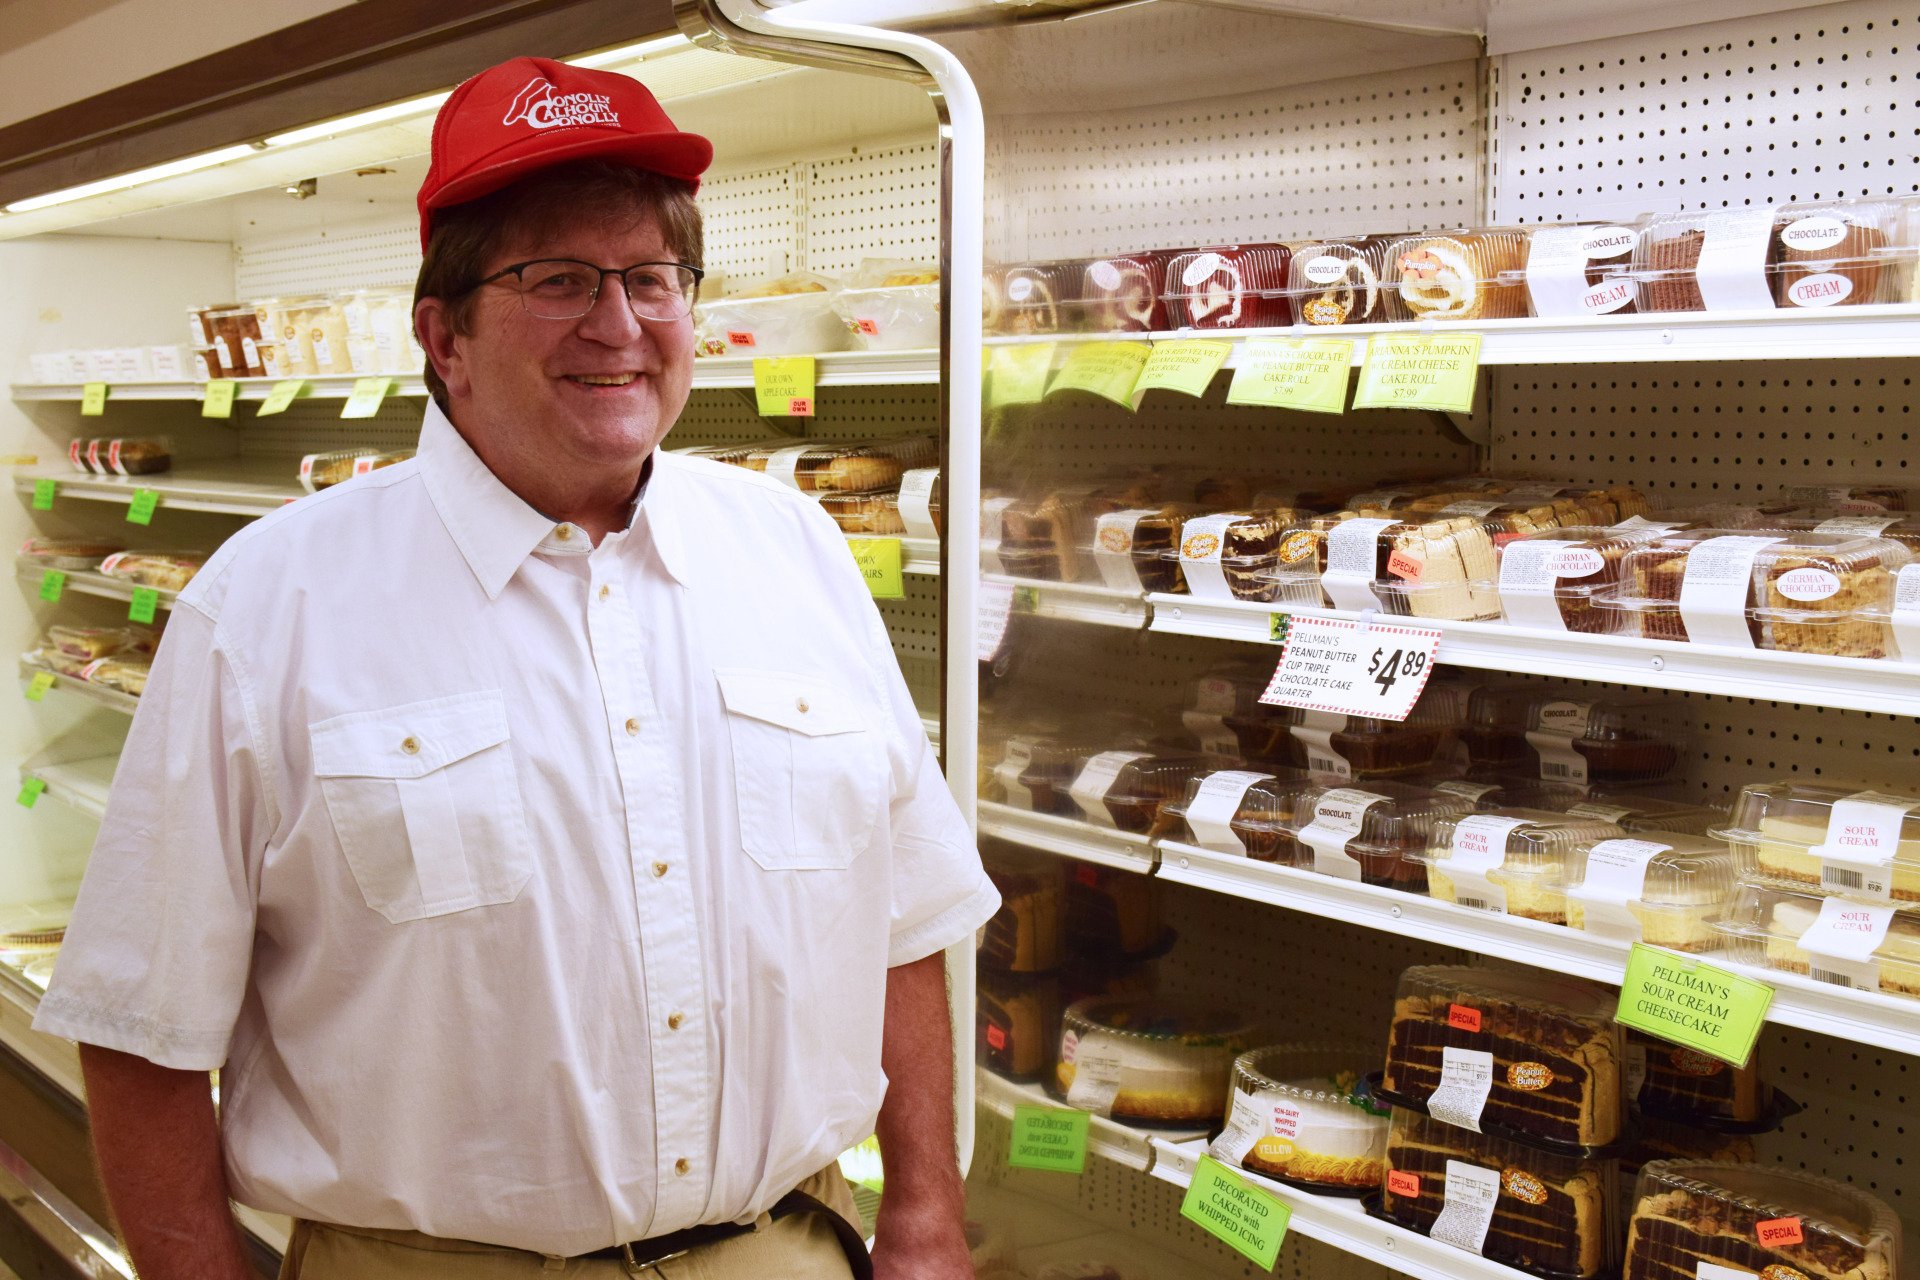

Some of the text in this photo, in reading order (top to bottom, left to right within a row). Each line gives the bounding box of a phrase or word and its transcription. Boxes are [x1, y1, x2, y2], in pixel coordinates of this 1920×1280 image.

[1789, 228, 1839, 239] CHOCOLATE
[1583, 235, 1631, 250] CHOCOLATE
[1308, 266, 1341, 274] CHOCOLATE
[1404, 260, 1436, 270] Pumpkin
[1797, 280, 1841, 300] CREAM
[1584, 285, 1627, 307] CREAM
[1422, 345, 1472, 355] PUMPKIN
[1292, 351, 1344, 361] CHOCOLATE
[1295, 363, 1330, 372] BUTTER
[1381, 360, 1417, 370] CREAM
[1418, 360, 1460, 370] CHEESE
[1264, 374, 1310, 384] CAKE ROLL
[1381, 374, 1437, 384] CAKE ROLL
[1393, 389, 1417, 398] $7.99
[1553, 553, 1591, 561] GERMAN
[1392, 558, 1418, 576] SPECIAL
[1546, 562, 1600, 571] CHOCOLATE
[1788, 575, 1825, 583] GERMAN
[1780, 584, 1834, 592] CHOCOLATE
[1294, 632, 1340, 646] PELLMAN'S
[1290, 647, 1357, 663] PEANUT BUTTER
[1286, 660, 1331, 674] CUP TRIPLE
[1280, 674, 1353, 690] CHOCOLATE CAKE
[1273, 686, 1312, 699] QUARTER
[1544, 709, 1577, 717] CHOCOLATE
[1318, 808, 1352, 819] CHOCOLATE
[1844, 826, 1875, 836] SOUR
[1464, 832, 1487, 843] SOUR
[1839, 836, 1878, 847] CREAM
[1459, 841, 1488, 853] CREAM
[1840, 912, 1870, 922] SOUR
[1833, 923, 1872, 932] CREAM
[1652, 966, 1730, 1000] PELLMAN'S
[1642, 982, 1730, 1020] SOUR CREAM
[1451, 1012, 1476, 1026] SPECIAL
[1637, 1000, 1723, 1038] CHEESECAKE
[1517, 1067, 1543, 1076] Peanut
[1517, 1076, 1541, 1085] Butter
[1274, 1107, 1299, 1118] NON-DAIRY
[1275, 1117, 1296, 1128] WHIPPED
[1274, 1127, 1295, 1137] TOPPING
[1259, 1144, 1292, 1154] YELLOW
[1391, 1178, 1415, 1191] SPECIAL
[1512, 1173, 1538, 1192] Peanut
[1511, 1181, 1534, 1199] Butter
[1213, 1176, 1269, 1218] DECORATED
[1212, 1193, 1260, 1230] CAKES with
[1198, 1200, 1265, 1251] WHIPPED ICING
[1763, 1226, 1798, 1240] SPECIAL
